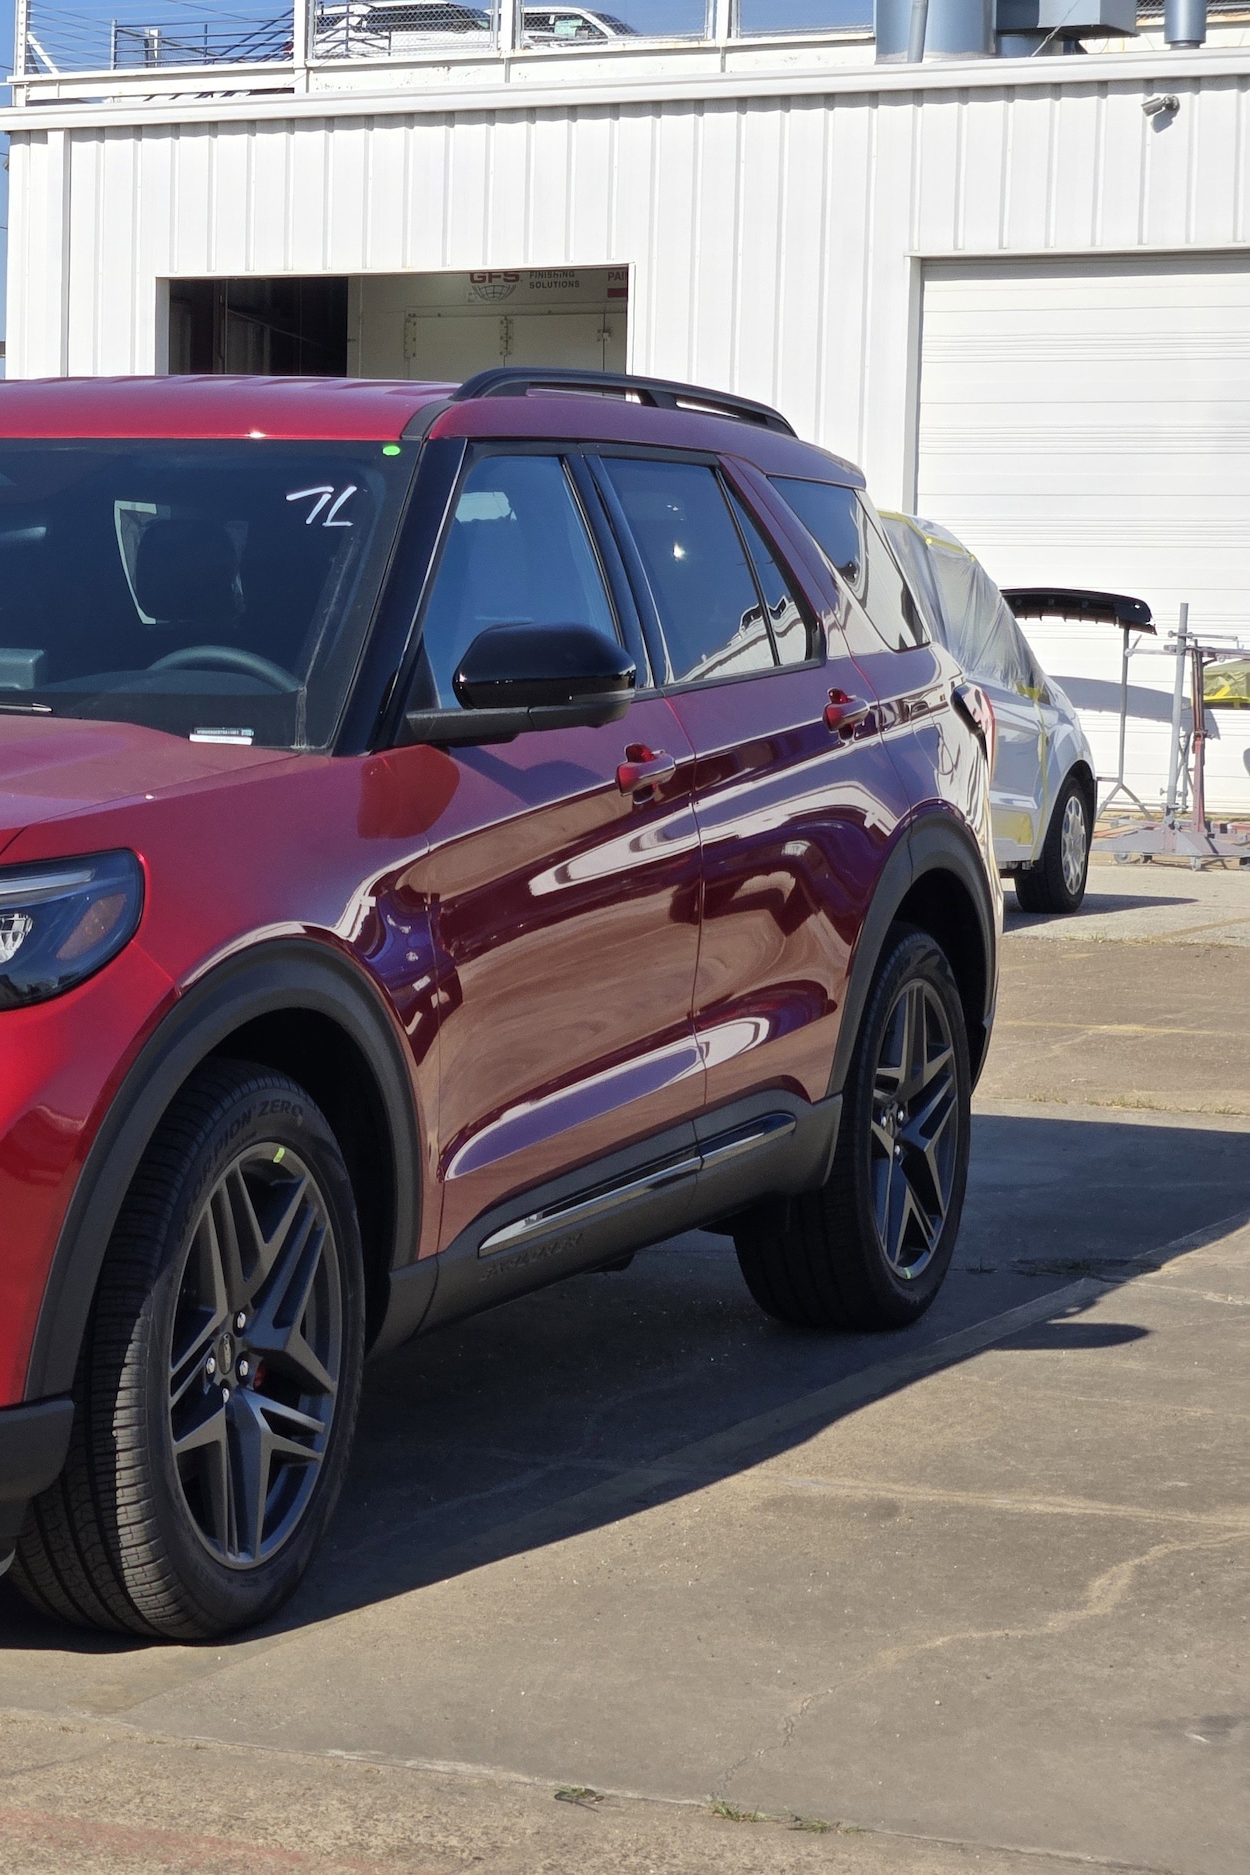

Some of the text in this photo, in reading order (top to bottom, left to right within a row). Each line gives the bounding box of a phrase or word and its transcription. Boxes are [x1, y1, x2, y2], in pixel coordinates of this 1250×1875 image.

[469, 272, 520, 284] GFS
[607, 271, 628, 281] PAI
[529, 281, 580, 289] SOLUTIONS
[257, 1098, 303, 1118] ZERO
